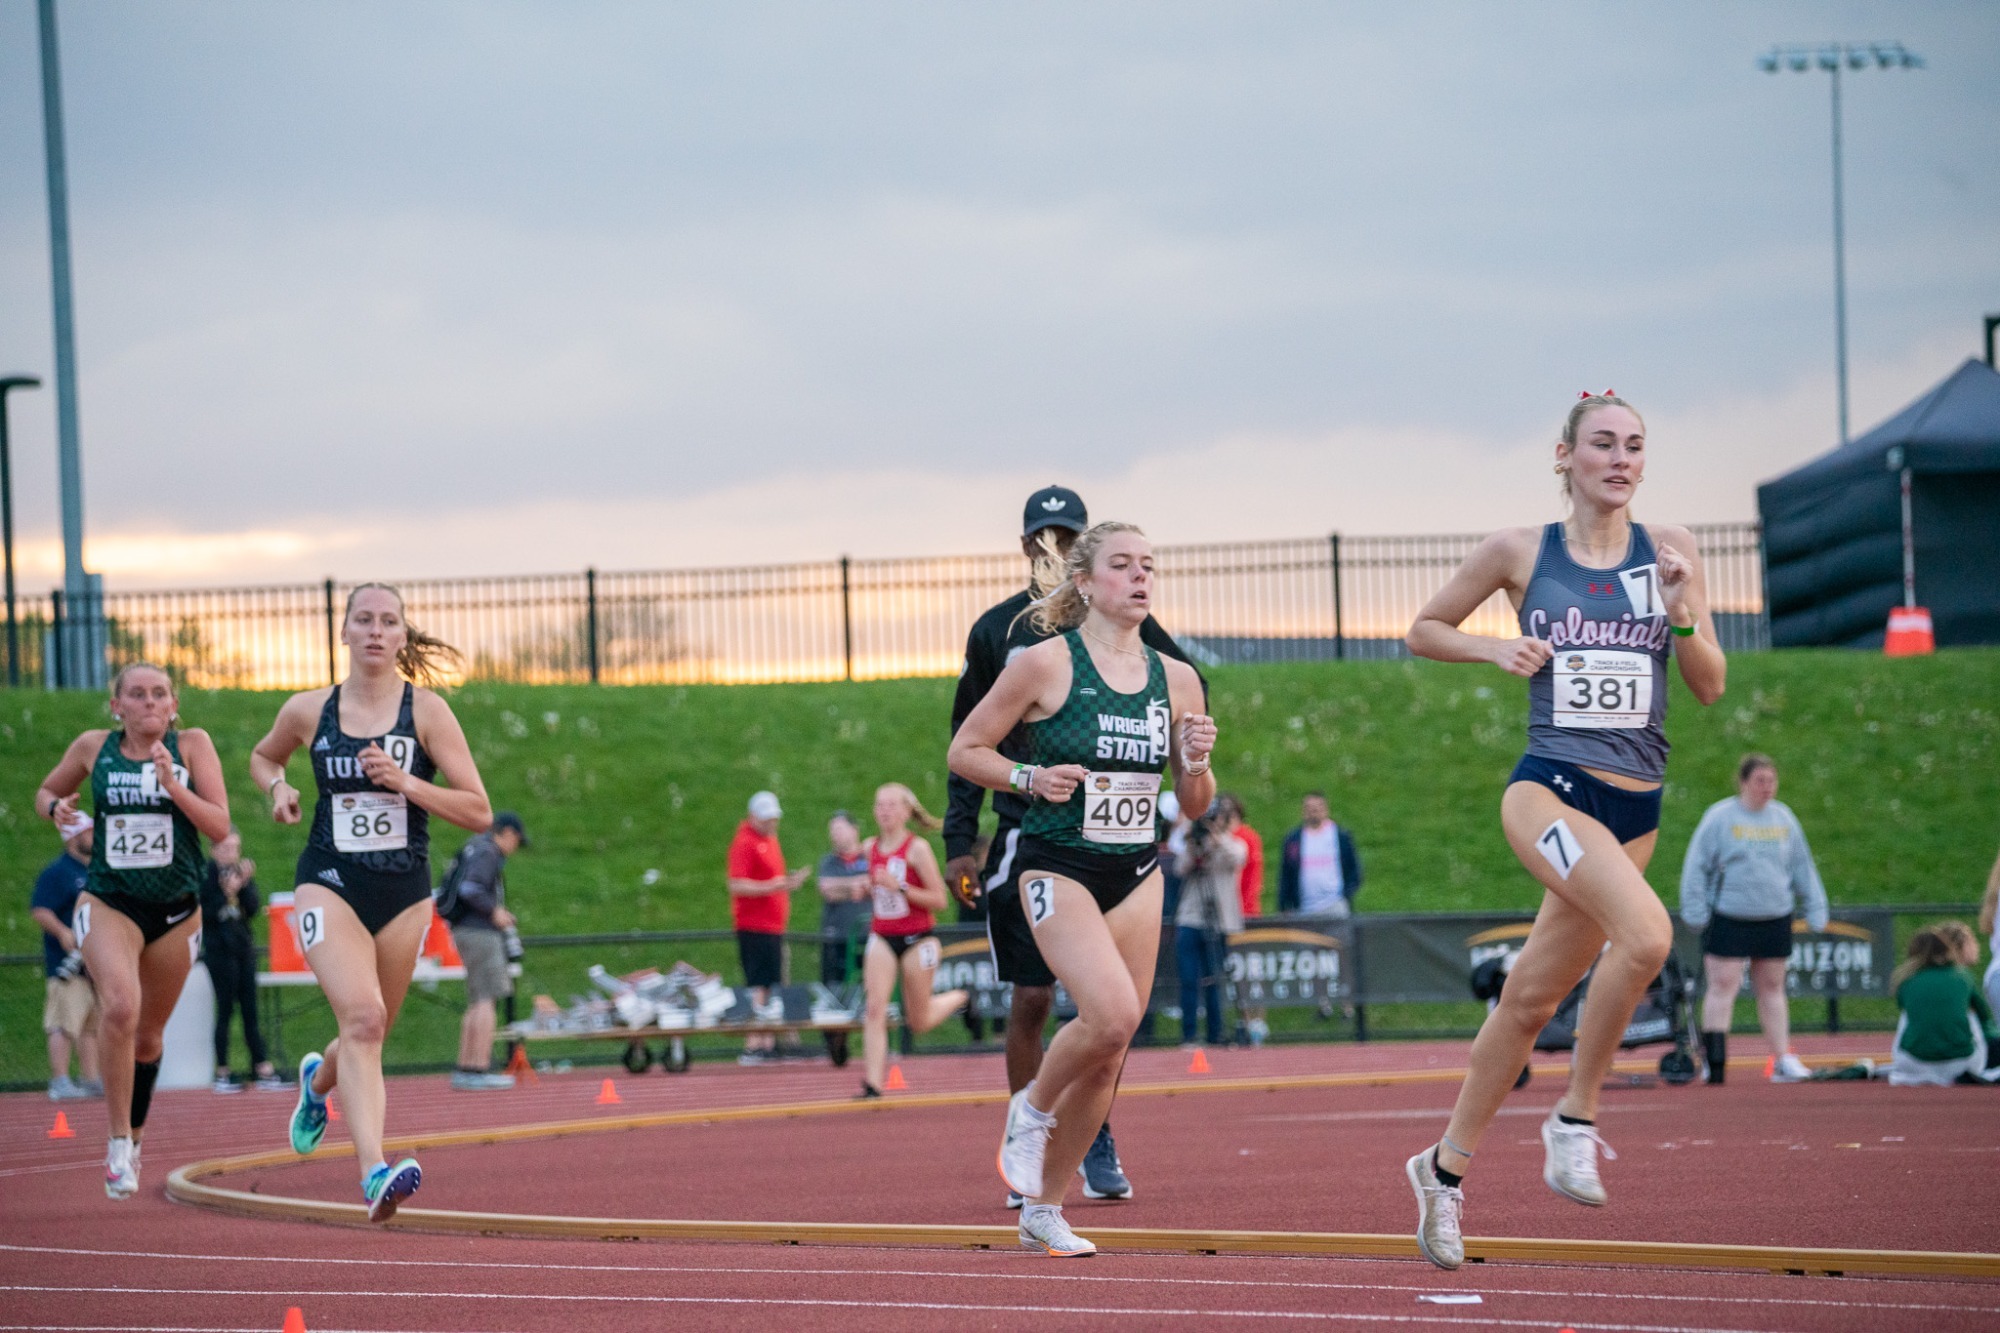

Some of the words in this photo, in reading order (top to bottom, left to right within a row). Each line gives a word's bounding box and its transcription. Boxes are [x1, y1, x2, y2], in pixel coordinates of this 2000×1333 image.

[1630, 568, 1653, 614] 7
[1529, 606, 1669, 651] Colonials
[1568, 677, 1636, 710] 381
[1097, 713, 1150, 737] WRIGH
[1154, 709, 1166, 753] 3
[391, 740, 407, 770] 9
[351, 811, 391, 838] 86
[1091, 797, 1152, 827] 409
[112, 833, 168, 854] 424
[1543, 826, 1570, 869] 7
[1030, 880, 1047, 922] 3
[303, 911, 317, 946] 9
[1225, 950, 1340, 981] ORIZON
